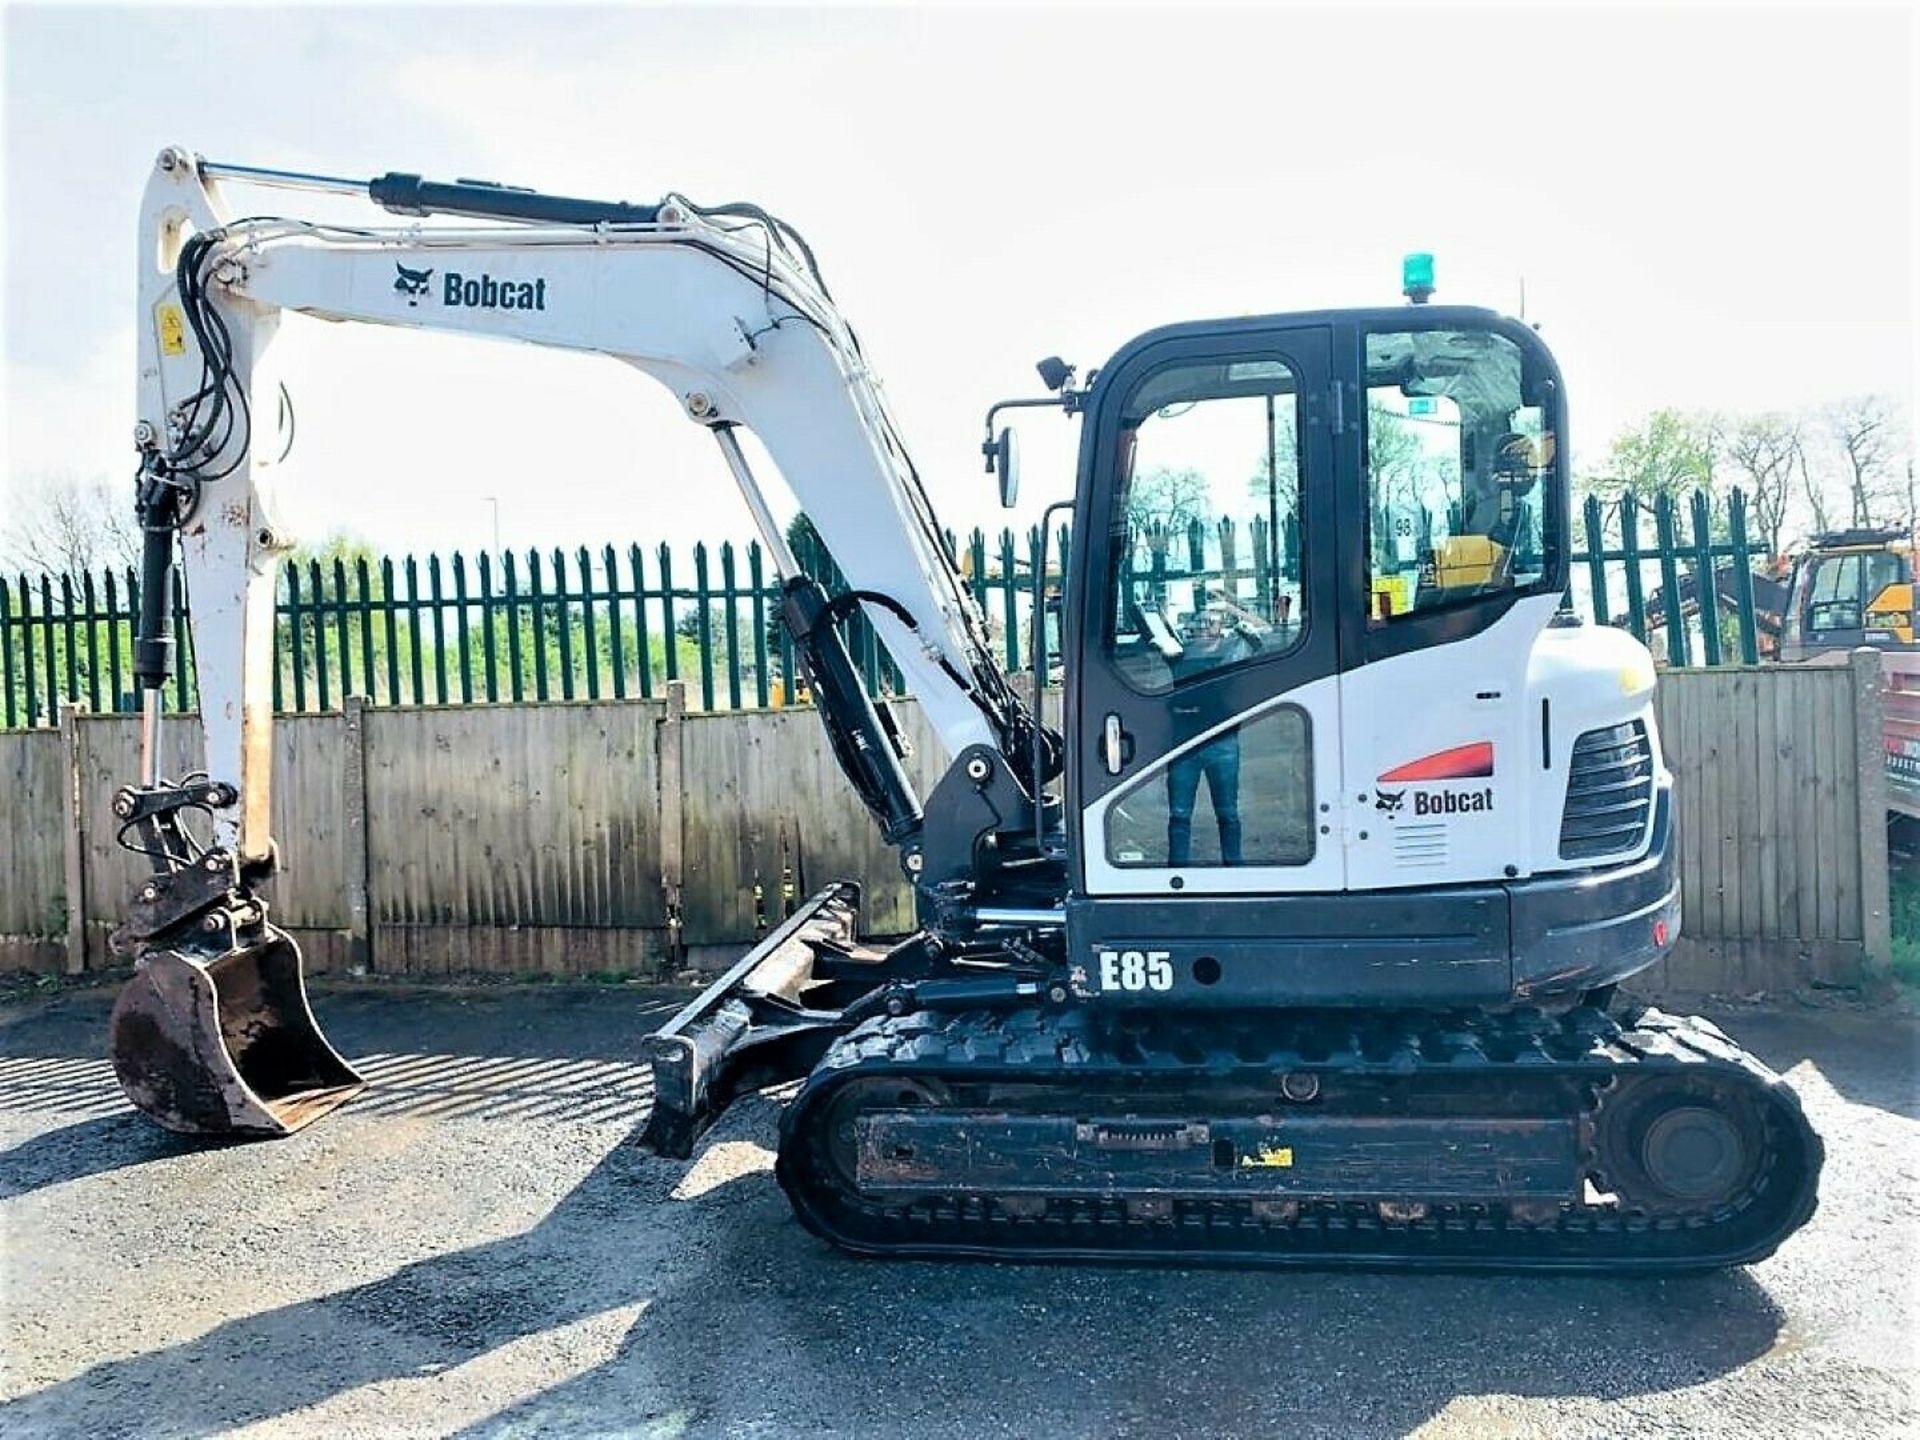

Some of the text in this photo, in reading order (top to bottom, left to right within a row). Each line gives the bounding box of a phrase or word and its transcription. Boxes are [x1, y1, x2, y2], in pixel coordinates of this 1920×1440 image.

[443, 272, 546, 311] Bobcat
[1414, 788, 1494, 816] Bobcat
[1100, 951, 1174, 991] E85
